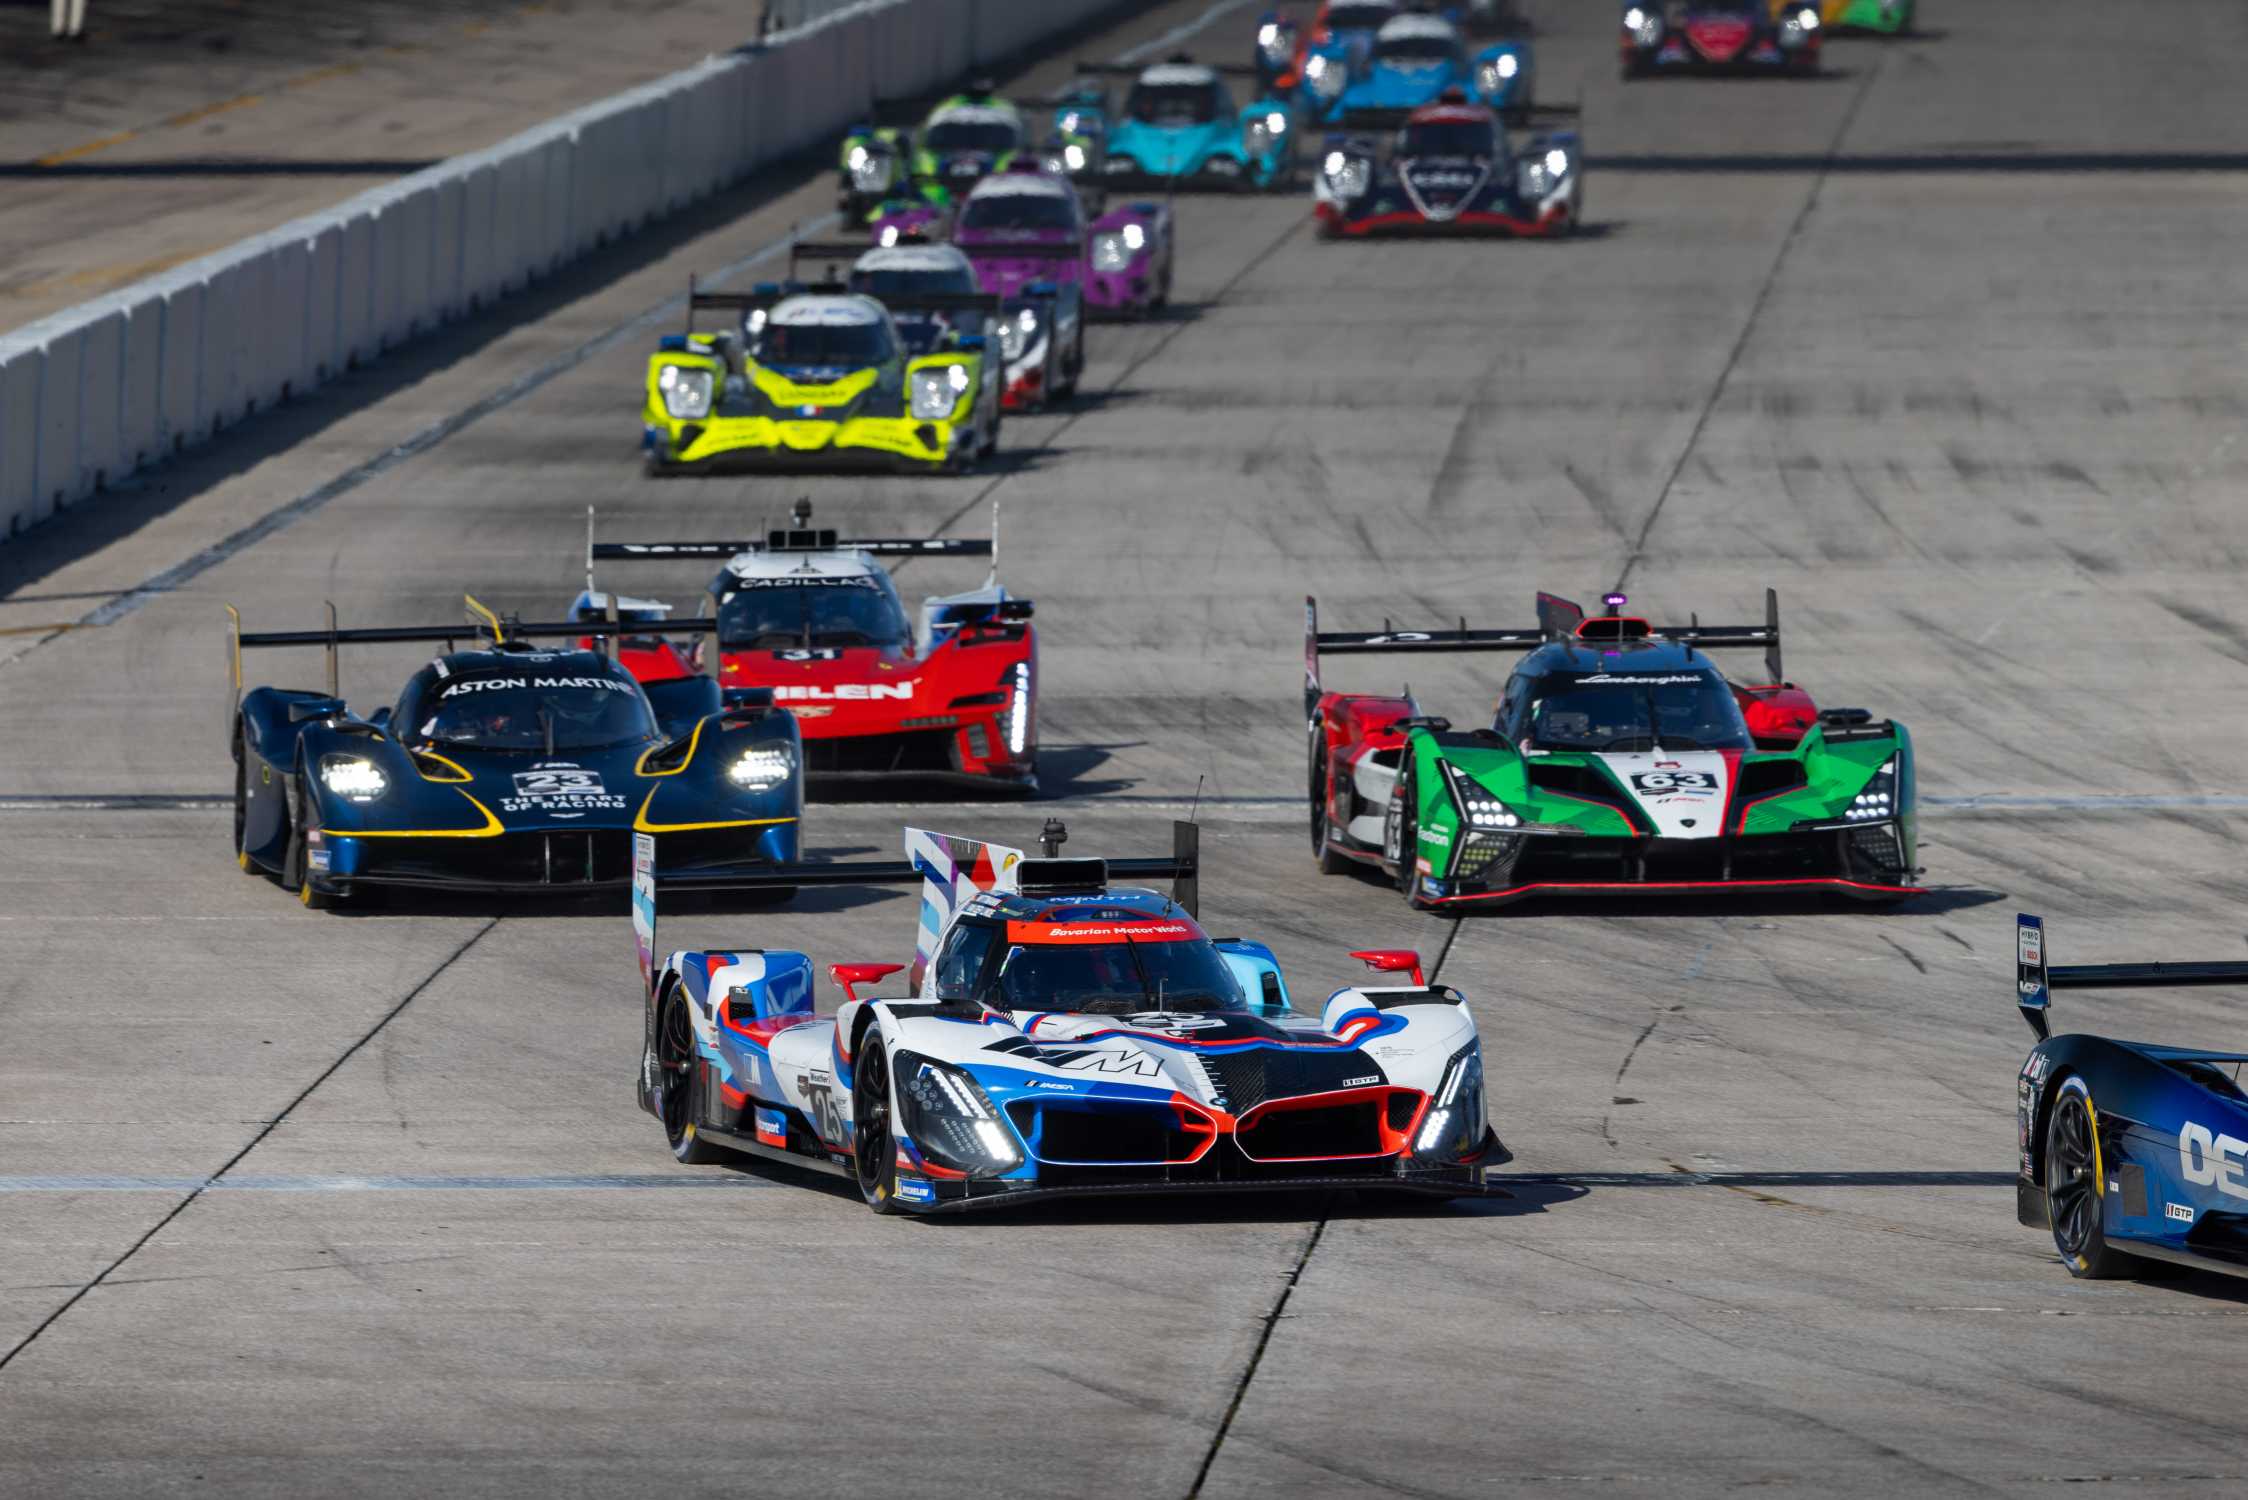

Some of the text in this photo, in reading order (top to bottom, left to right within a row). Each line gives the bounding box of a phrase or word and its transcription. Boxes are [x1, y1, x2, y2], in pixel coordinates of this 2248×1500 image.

[440, 678, 526, 699] ASTON
[526, 774, 593, 790] 23
[1640, 773, 1709, 788] 63
[499, 794, 627, 805] THE HEART
[504, 800, 627, 811] OF RACING
[1049, 927, 1111, 937] Bavarian
[1113, 926, 1153, 935] Motor
[815, 1089, 843, 1142] 25
[2174, 1206, 2193, 1219] GTP
